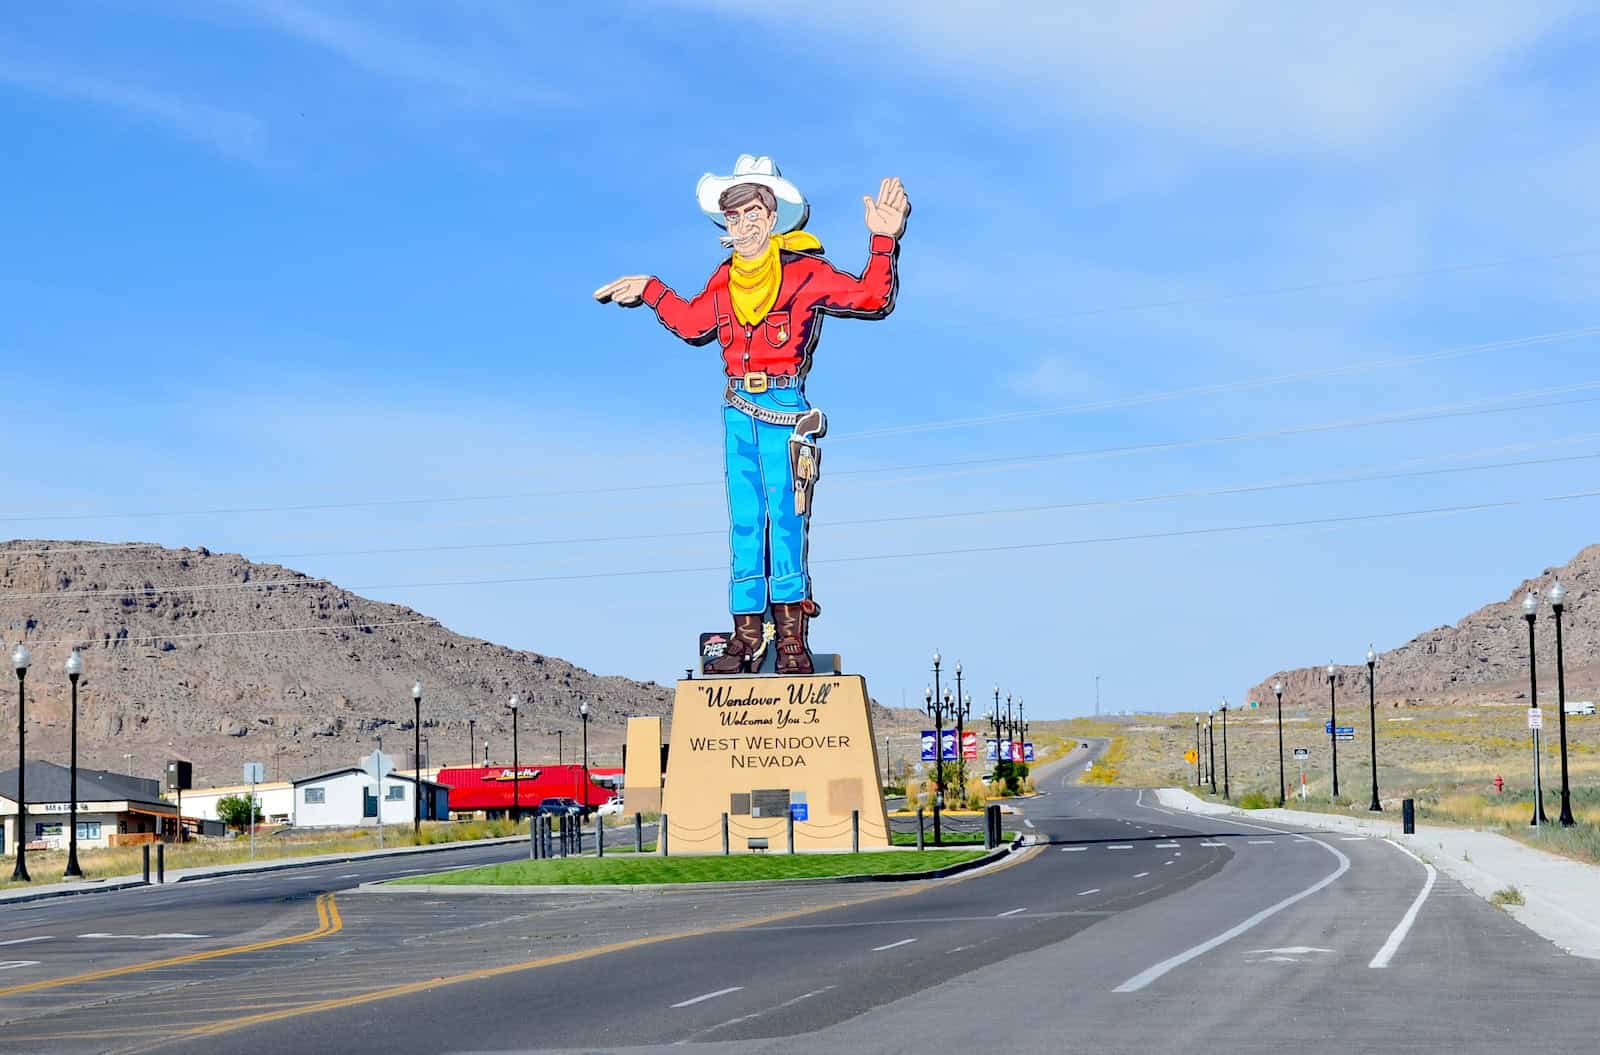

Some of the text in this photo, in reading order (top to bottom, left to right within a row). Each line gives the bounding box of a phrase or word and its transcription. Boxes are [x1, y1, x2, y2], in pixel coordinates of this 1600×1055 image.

[786, 682, 840, 705] Will"
[719, 708, 820, 729] Welcomes You To
[689, 735, 851, 751] WEST WENDOVER
[731, 754, 807, 769] NEVADA
